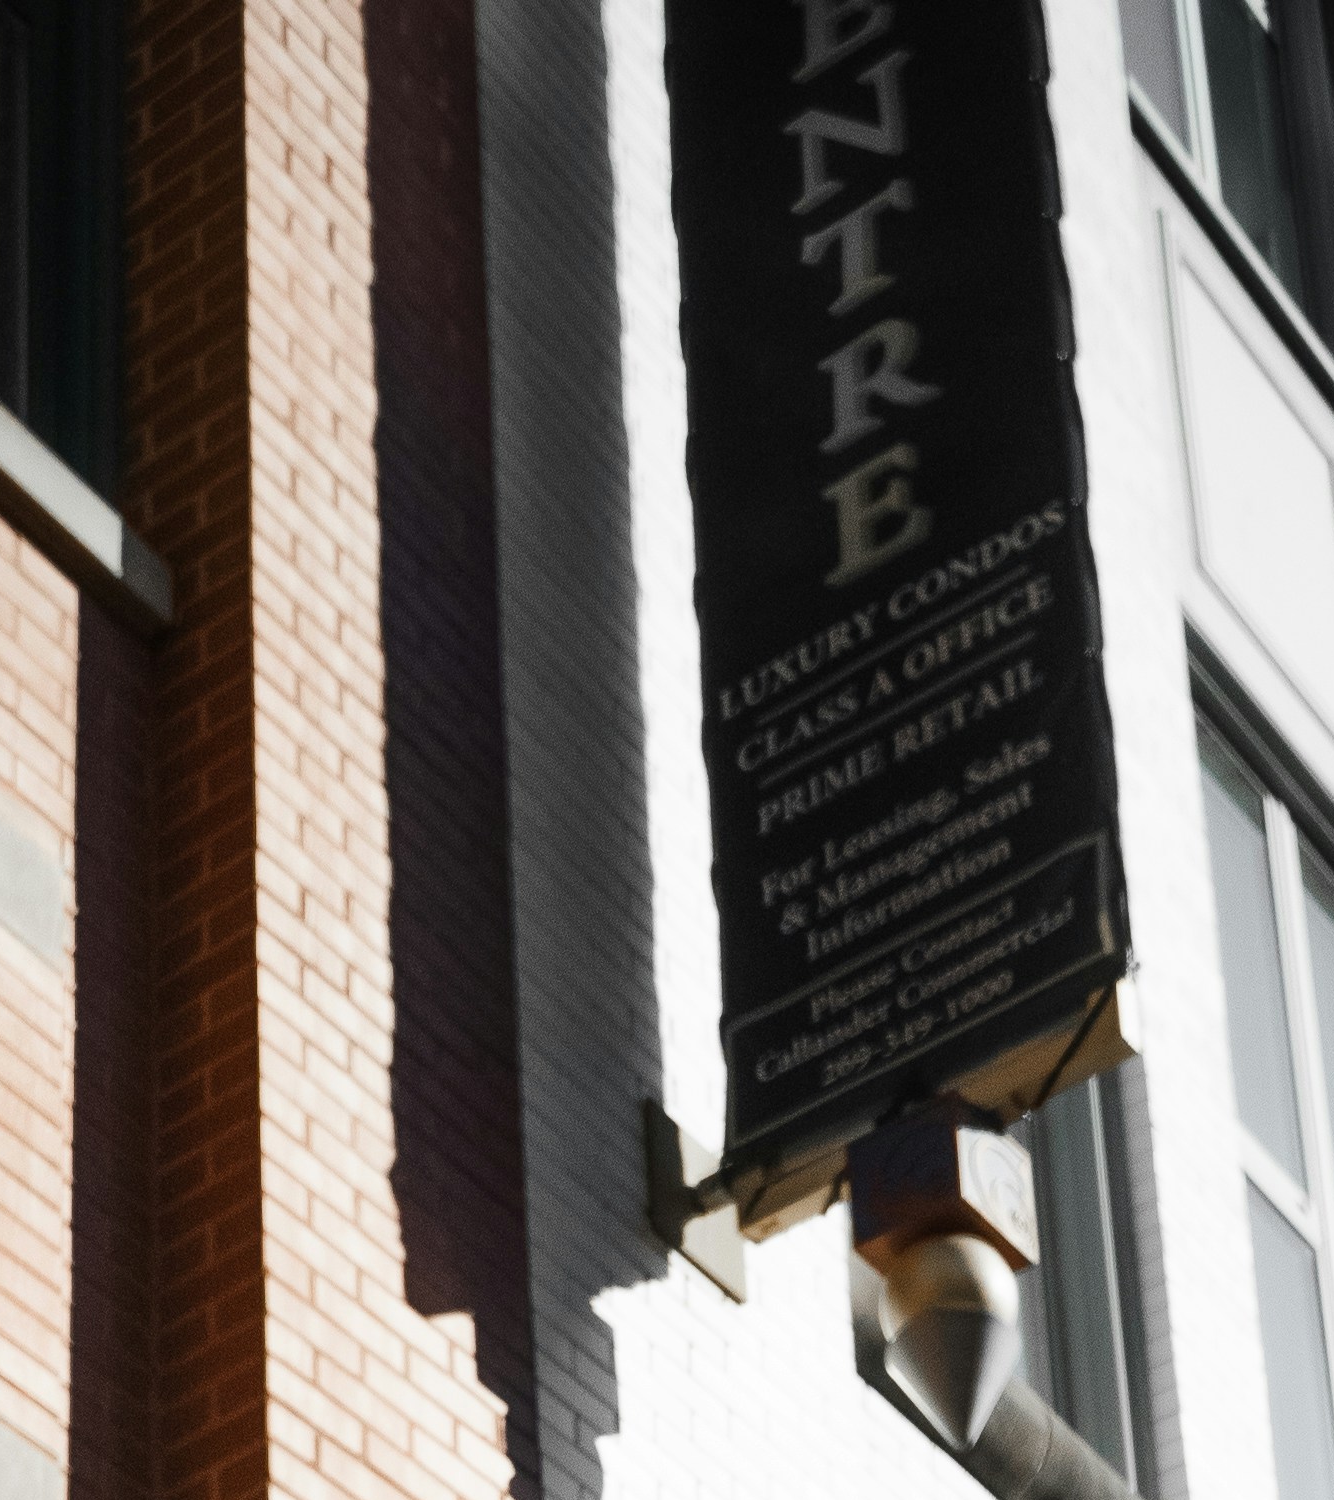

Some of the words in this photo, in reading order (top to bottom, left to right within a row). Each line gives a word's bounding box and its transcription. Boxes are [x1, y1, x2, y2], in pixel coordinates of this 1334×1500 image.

[719, 601, 878, 721] LUXURY
[886, 499, 1066, 622] CONDOS
[735, 684, 861, 773] CLASS
[866, 667, 896, 707] A
[902, 573, 1054, 680] OFFICE
[757, 740, 885, 837] PRIME
[893, 658, 1044, 763] RETAIL
[760, 856, 815, 908] For
[963, 732, 1052, 796] Sales
[806, 836, 1013, 961] Information
[816, 780, 1034, 918] Management
[896, 896, 1075, 1010] Commercial
